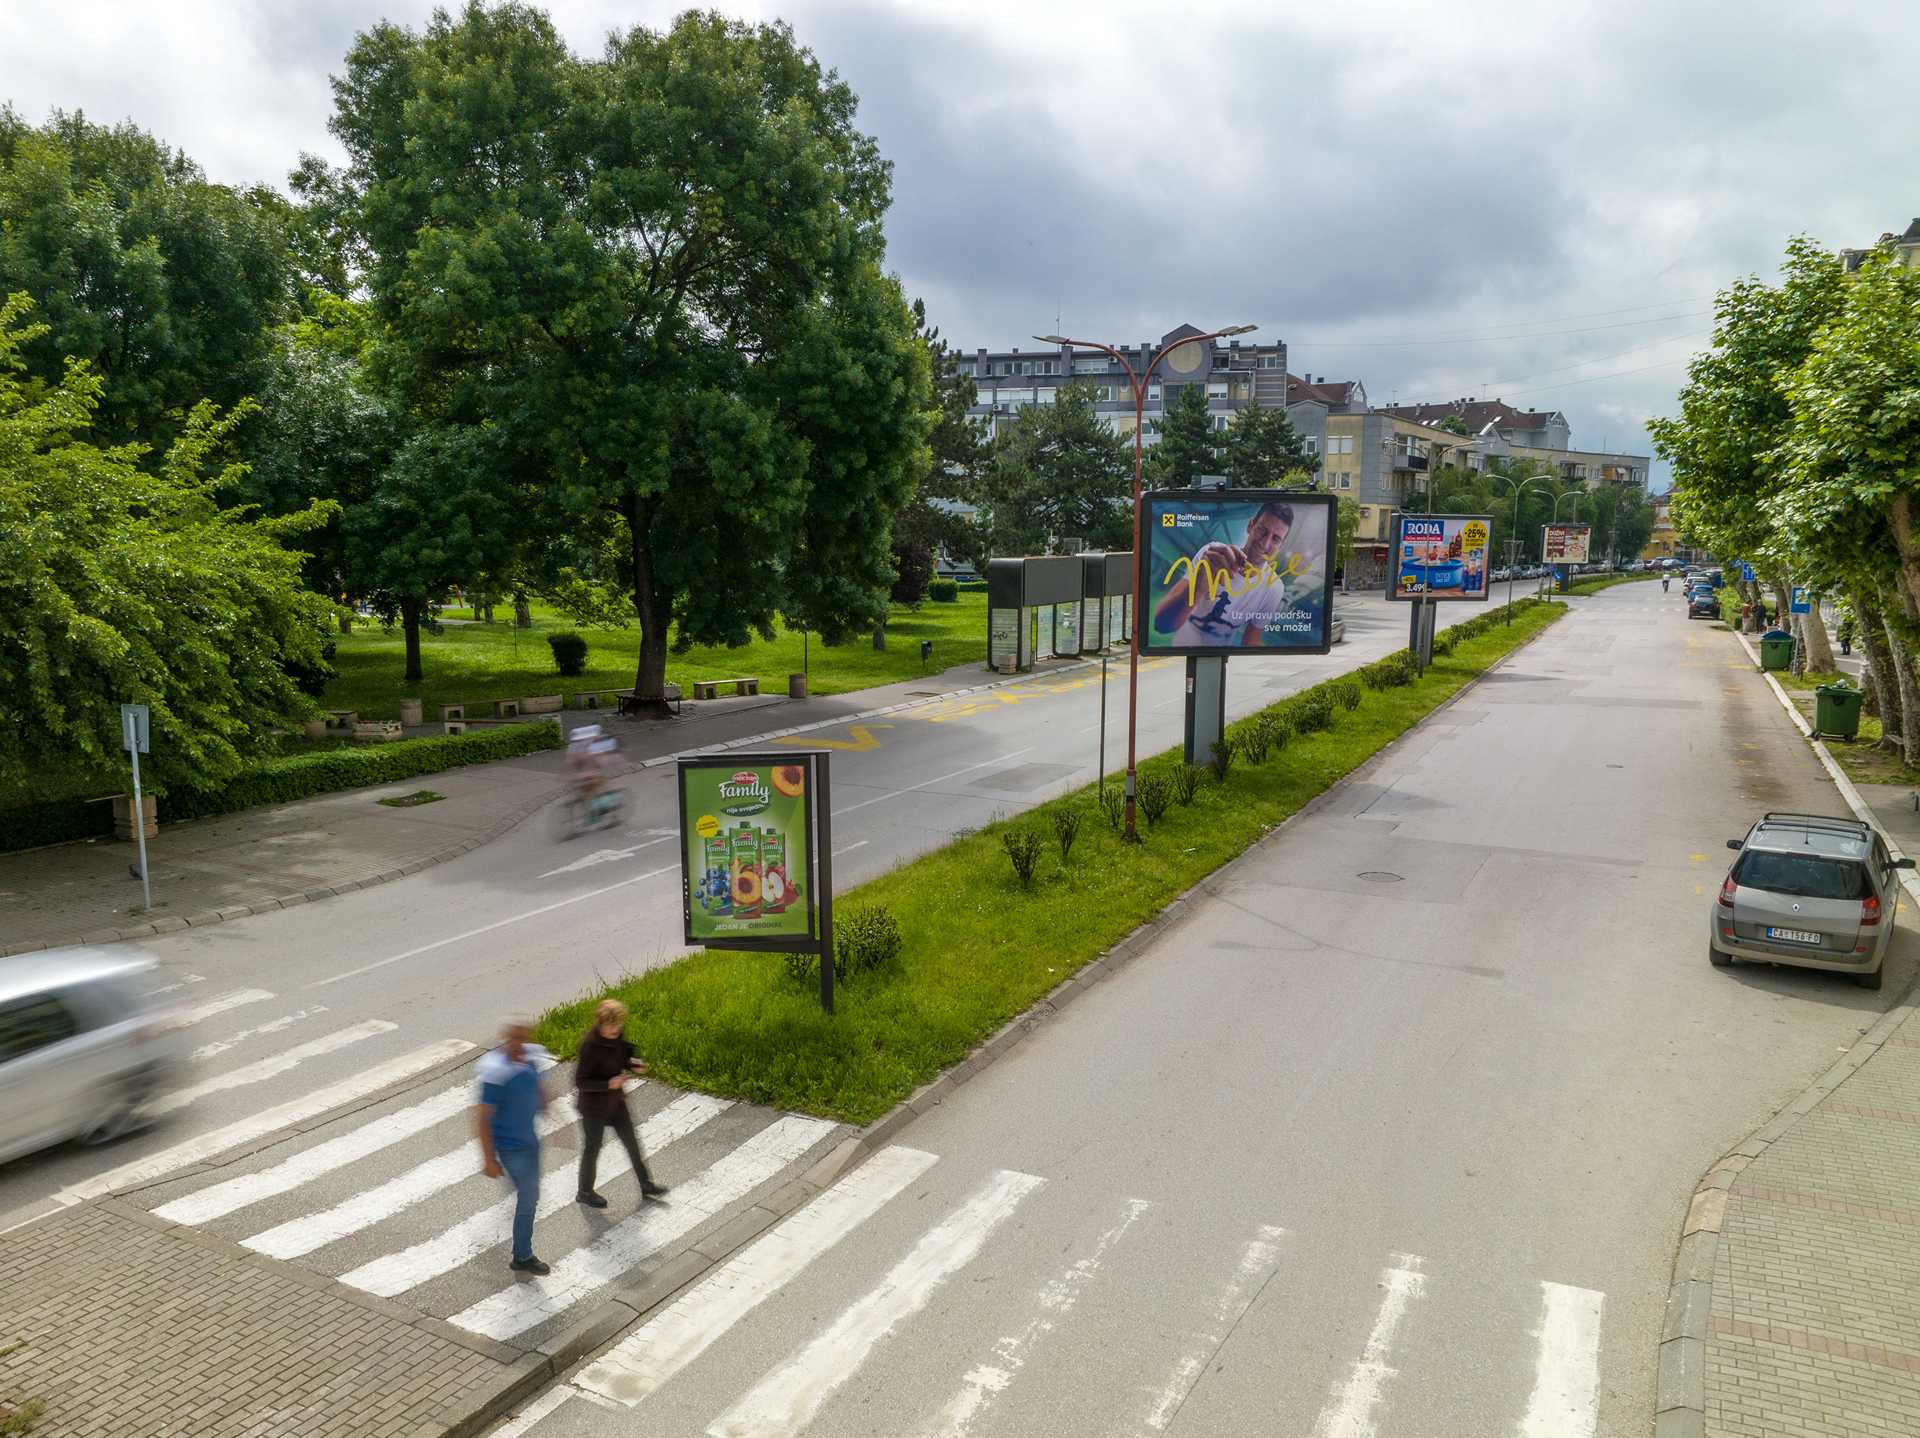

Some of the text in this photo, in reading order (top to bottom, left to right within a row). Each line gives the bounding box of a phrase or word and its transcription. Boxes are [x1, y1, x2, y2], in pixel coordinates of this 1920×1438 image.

[1177, 513, 1209, 521] Raiffeisen
[1408, 523, 1440, 534] RODA
[1231, 610, 1312, 622] Uz pravu podršku
[1264, 622, 1312, 632] sve može!
[719, 781, 770, 803] Family
